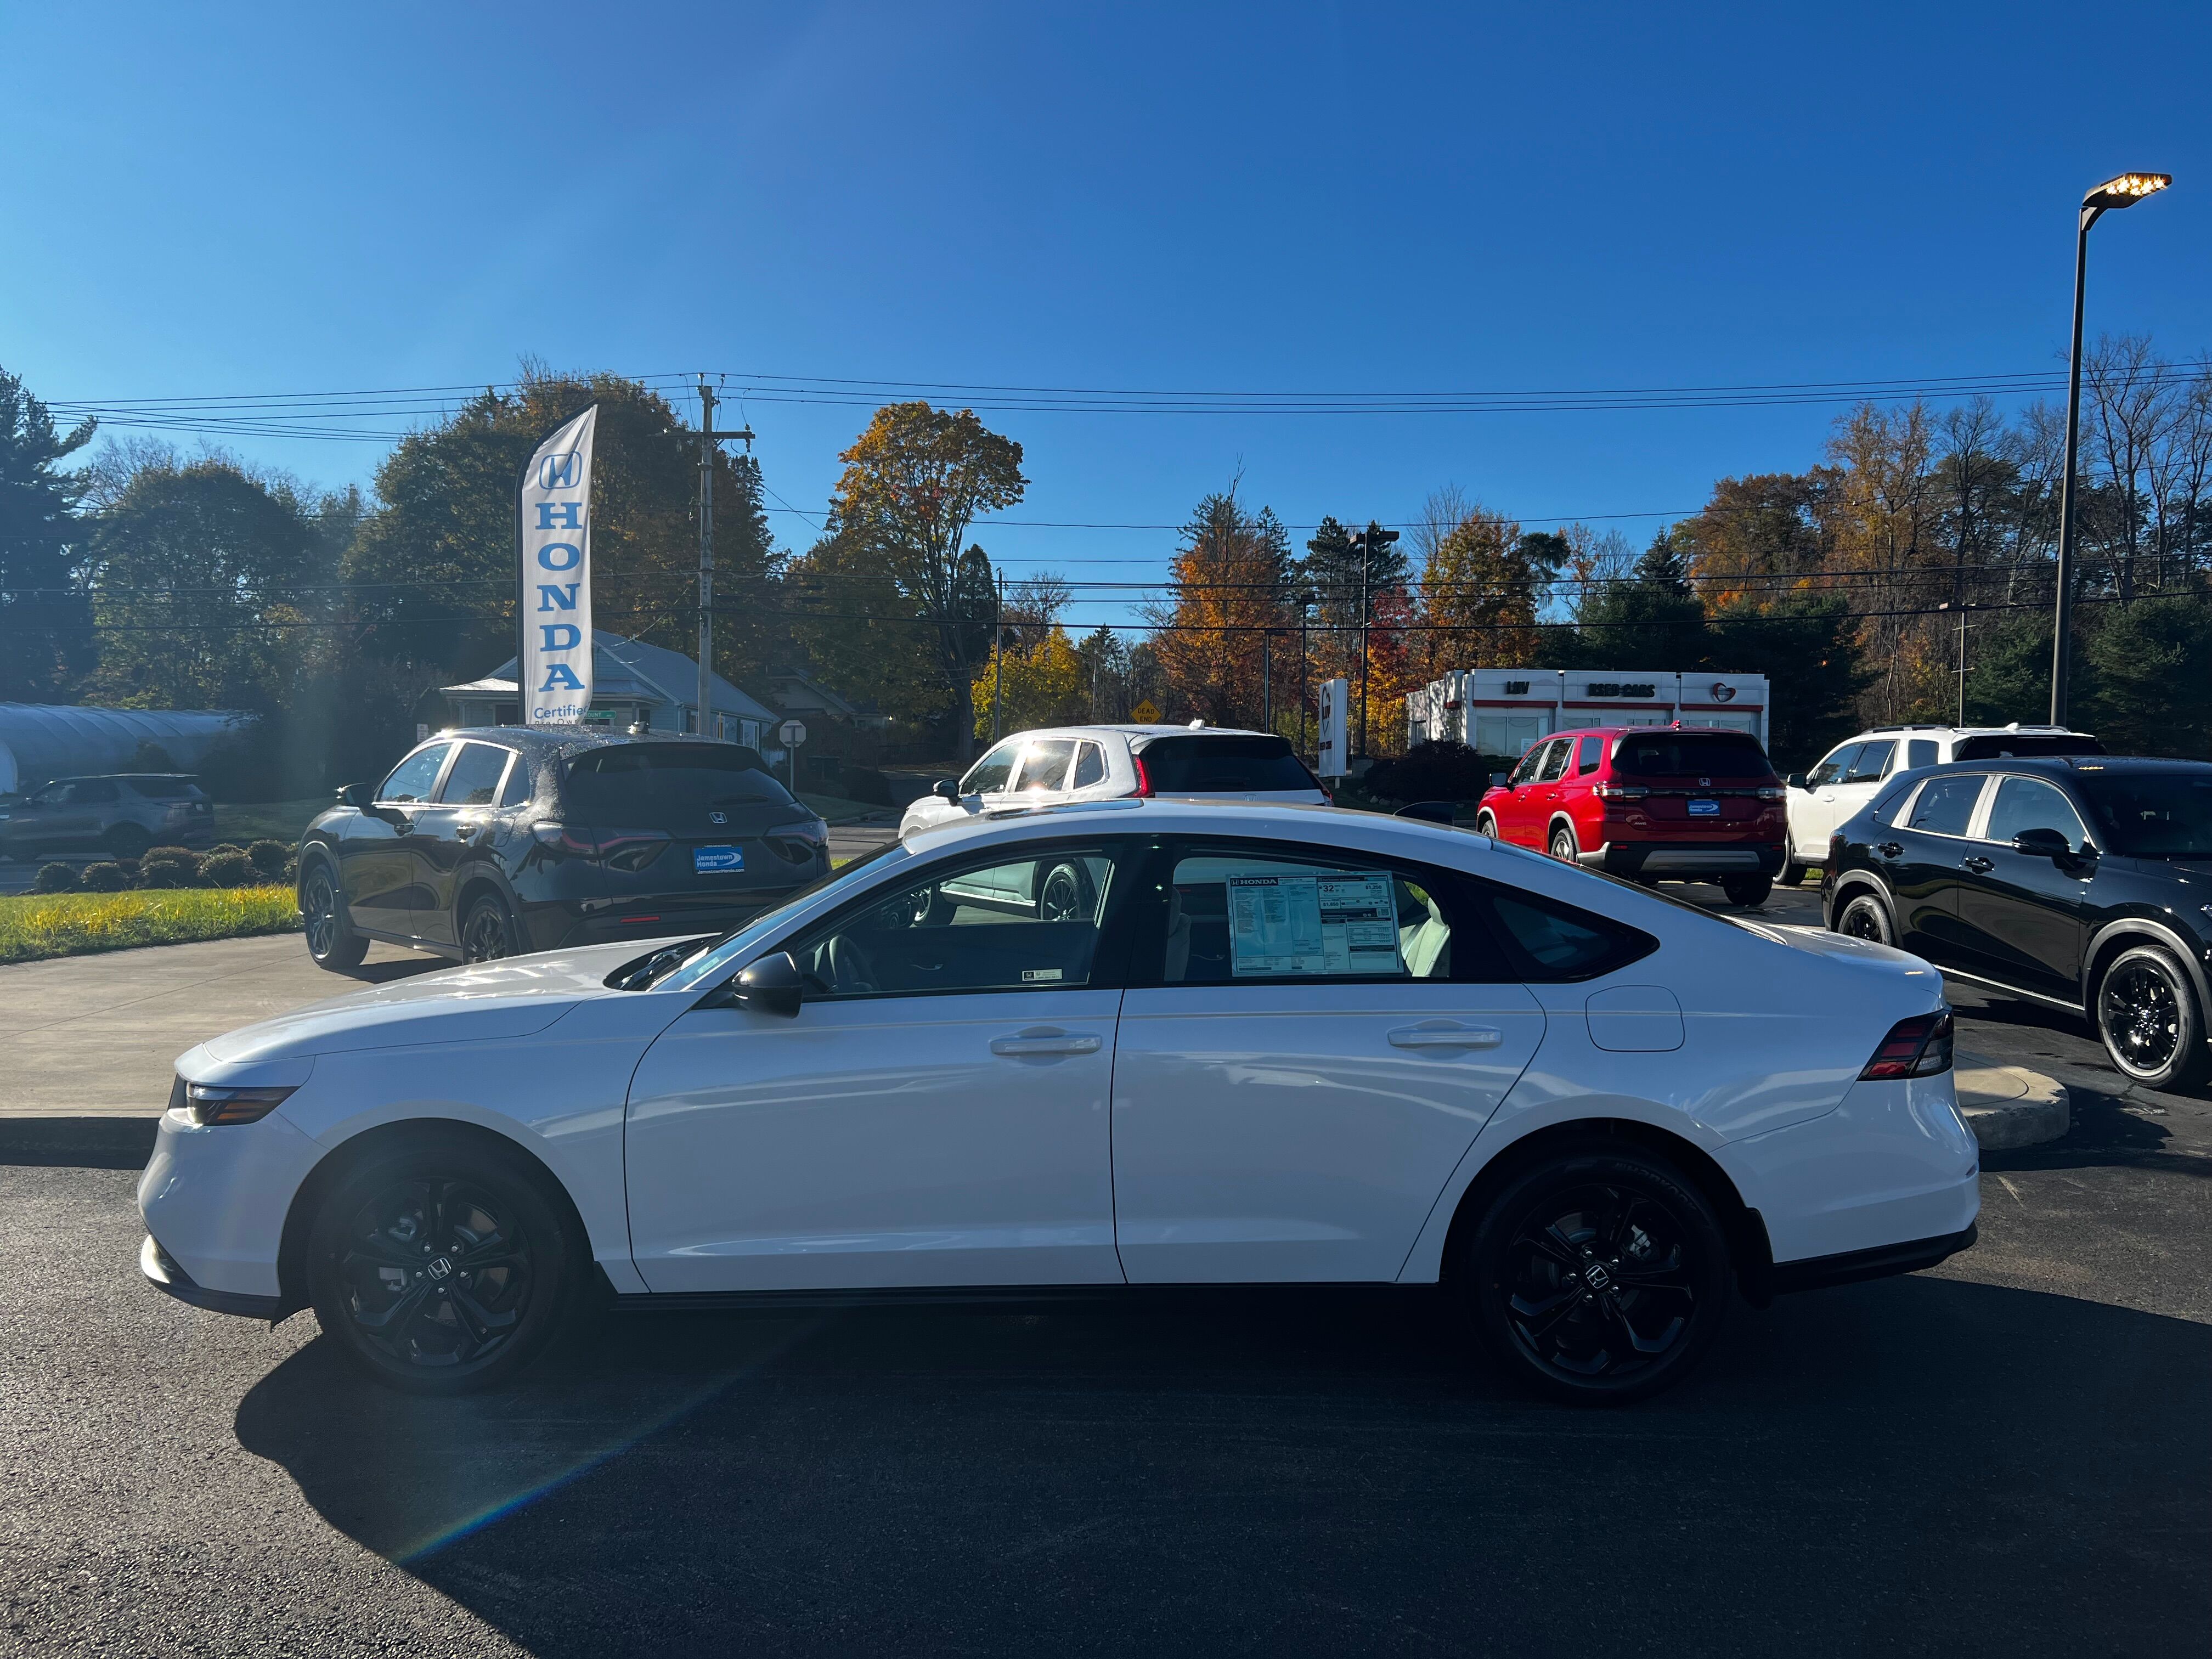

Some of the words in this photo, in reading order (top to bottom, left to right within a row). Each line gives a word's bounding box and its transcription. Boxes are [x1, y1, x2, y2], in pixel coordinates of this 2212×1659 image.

[535, 502, 585, 693] HONDA
[1506, 681, 1530, 695] LUV
[1588, 683, 1619, 697] USED
[1622, 684, 1655, 697] CARS
